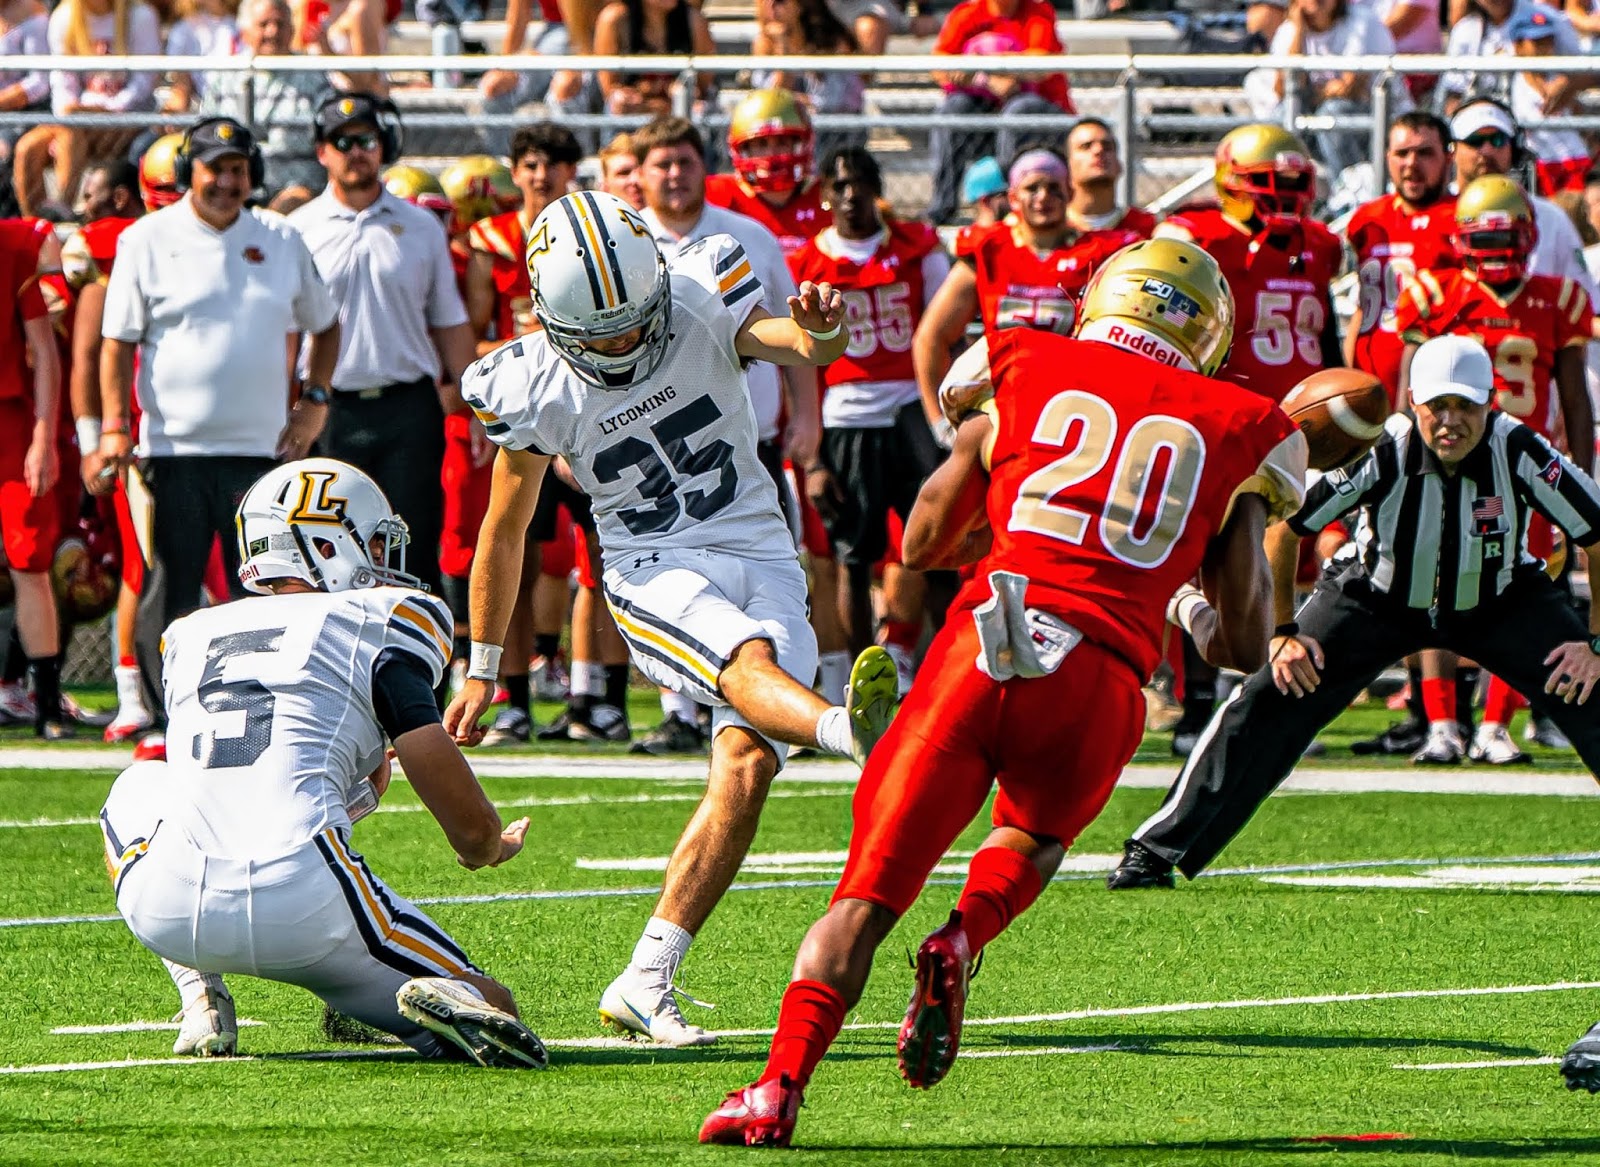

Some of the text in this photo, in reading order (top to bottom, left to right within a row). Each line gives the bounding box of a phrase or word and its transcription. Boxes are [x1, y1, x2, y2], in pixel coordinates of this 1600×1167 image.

[841, 282, 912, 358] 85
[1107, 325, 1182, 368] Riddell
[1251, 290, 1324, 366] 59
[598, 385, 677, 435] LYCOMING
[592, 393, 738, 536] 35
[1007, 389, 1206, 569] 20
[1484, 541, 1502, 559] R
[192, 626, 287, 769] 5
